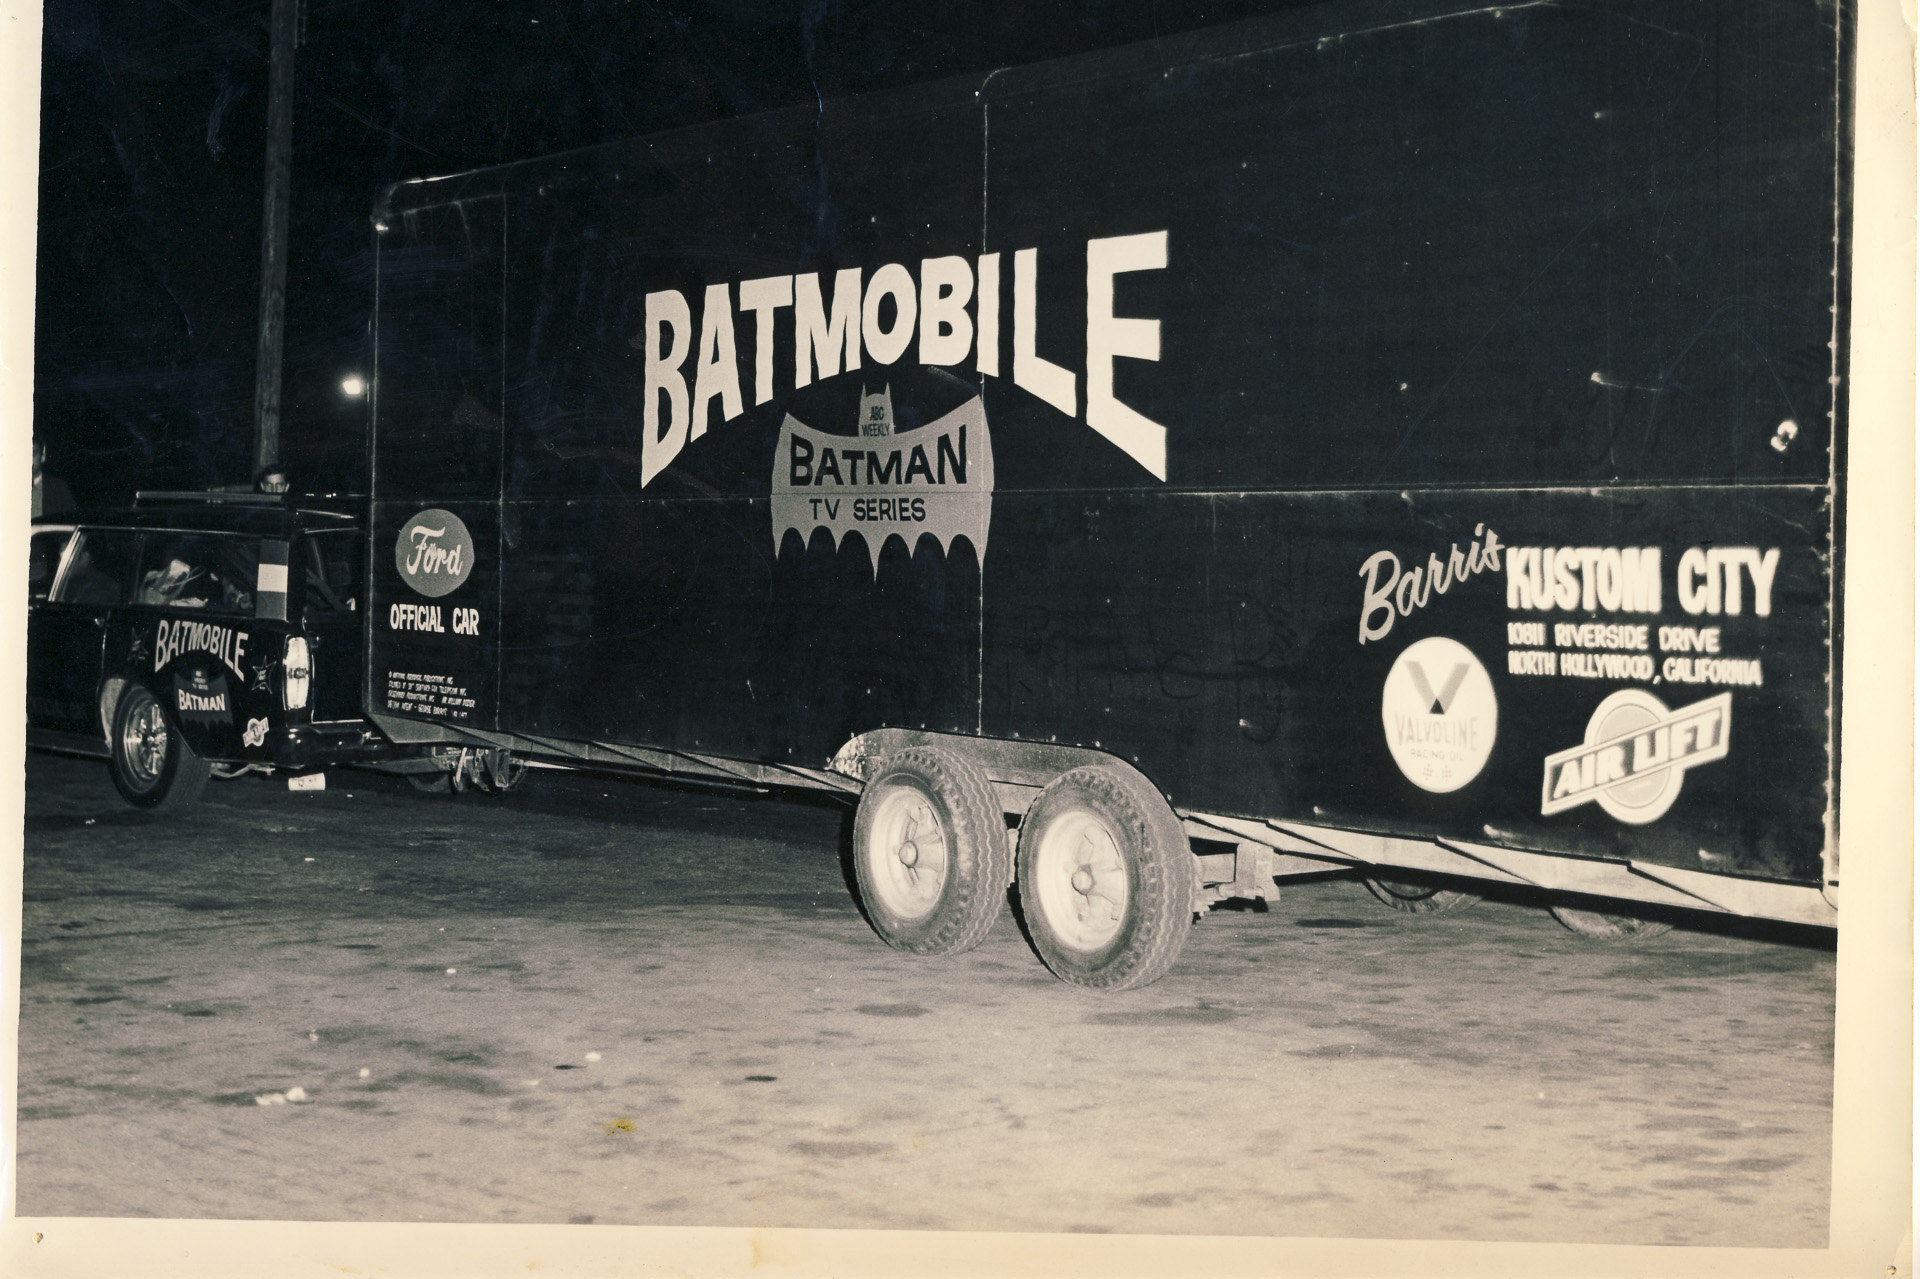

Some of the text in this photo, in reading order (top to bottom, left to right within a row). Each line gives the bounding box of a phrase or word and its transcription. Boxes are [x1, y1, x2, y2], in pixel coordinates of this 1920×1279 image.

[641, 230, 1168, 489] BATMOBILE
[862, 423, 890, 437] WEEKLY
[870, 406, 885, 421] ABC
[790, 424, 967, 486] BATMAN
[809, 498, 926, 521] TV SERIES
[406, 525, 463, 576] Ford
[1358, 523, 1504, 645] Barris
[1506, 546, 1780, 617] KUSTOM CITY
[390, 603, 480, 636] OFFICIAL CAR
[1554, 623, 1649, 650] RIVERSIDE
[1658, 627, 1721, 652] DRIVE
[154, 619, 249, 683] BATMOBILE
[1507, 650, 1556, 676] NORTH
[1662, 658, 1763, 686] CALIFORNIA
[178, 688, 225, 711] BATMAN
[1394, 711, 1479, 752] VALVOLINE
[1410, 748, 1464, 761] RACING OIL
[1553, 707, 1722, 800] AIR LIFT
